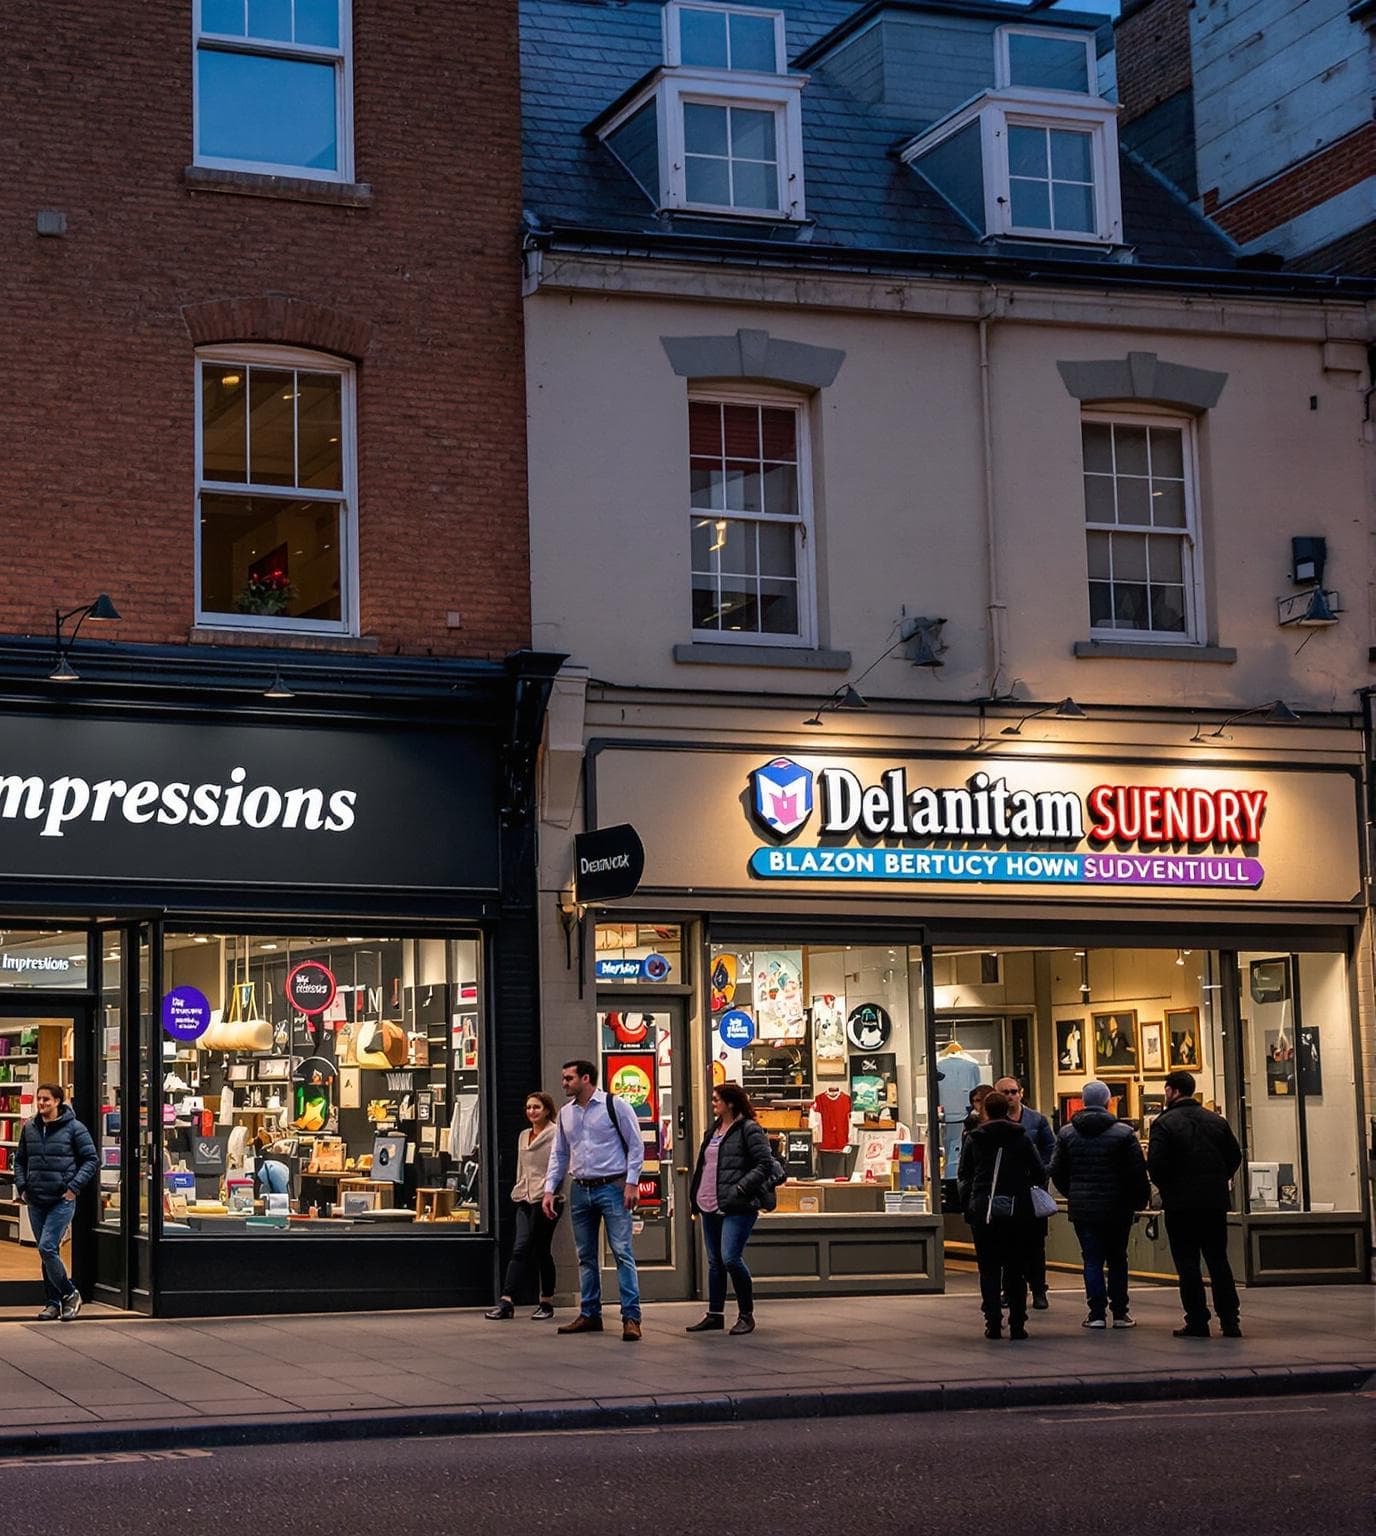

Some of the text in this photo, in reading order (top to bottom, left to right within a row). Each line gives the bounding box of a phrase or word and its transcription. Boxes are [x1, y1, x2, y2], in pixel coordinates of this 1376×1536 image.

[822, 767, 1268, 843] Delanitam SUENDRY
[769, 851, 1250, 882] BLAZON BERTUCY HOWN SUDVENTIULL
